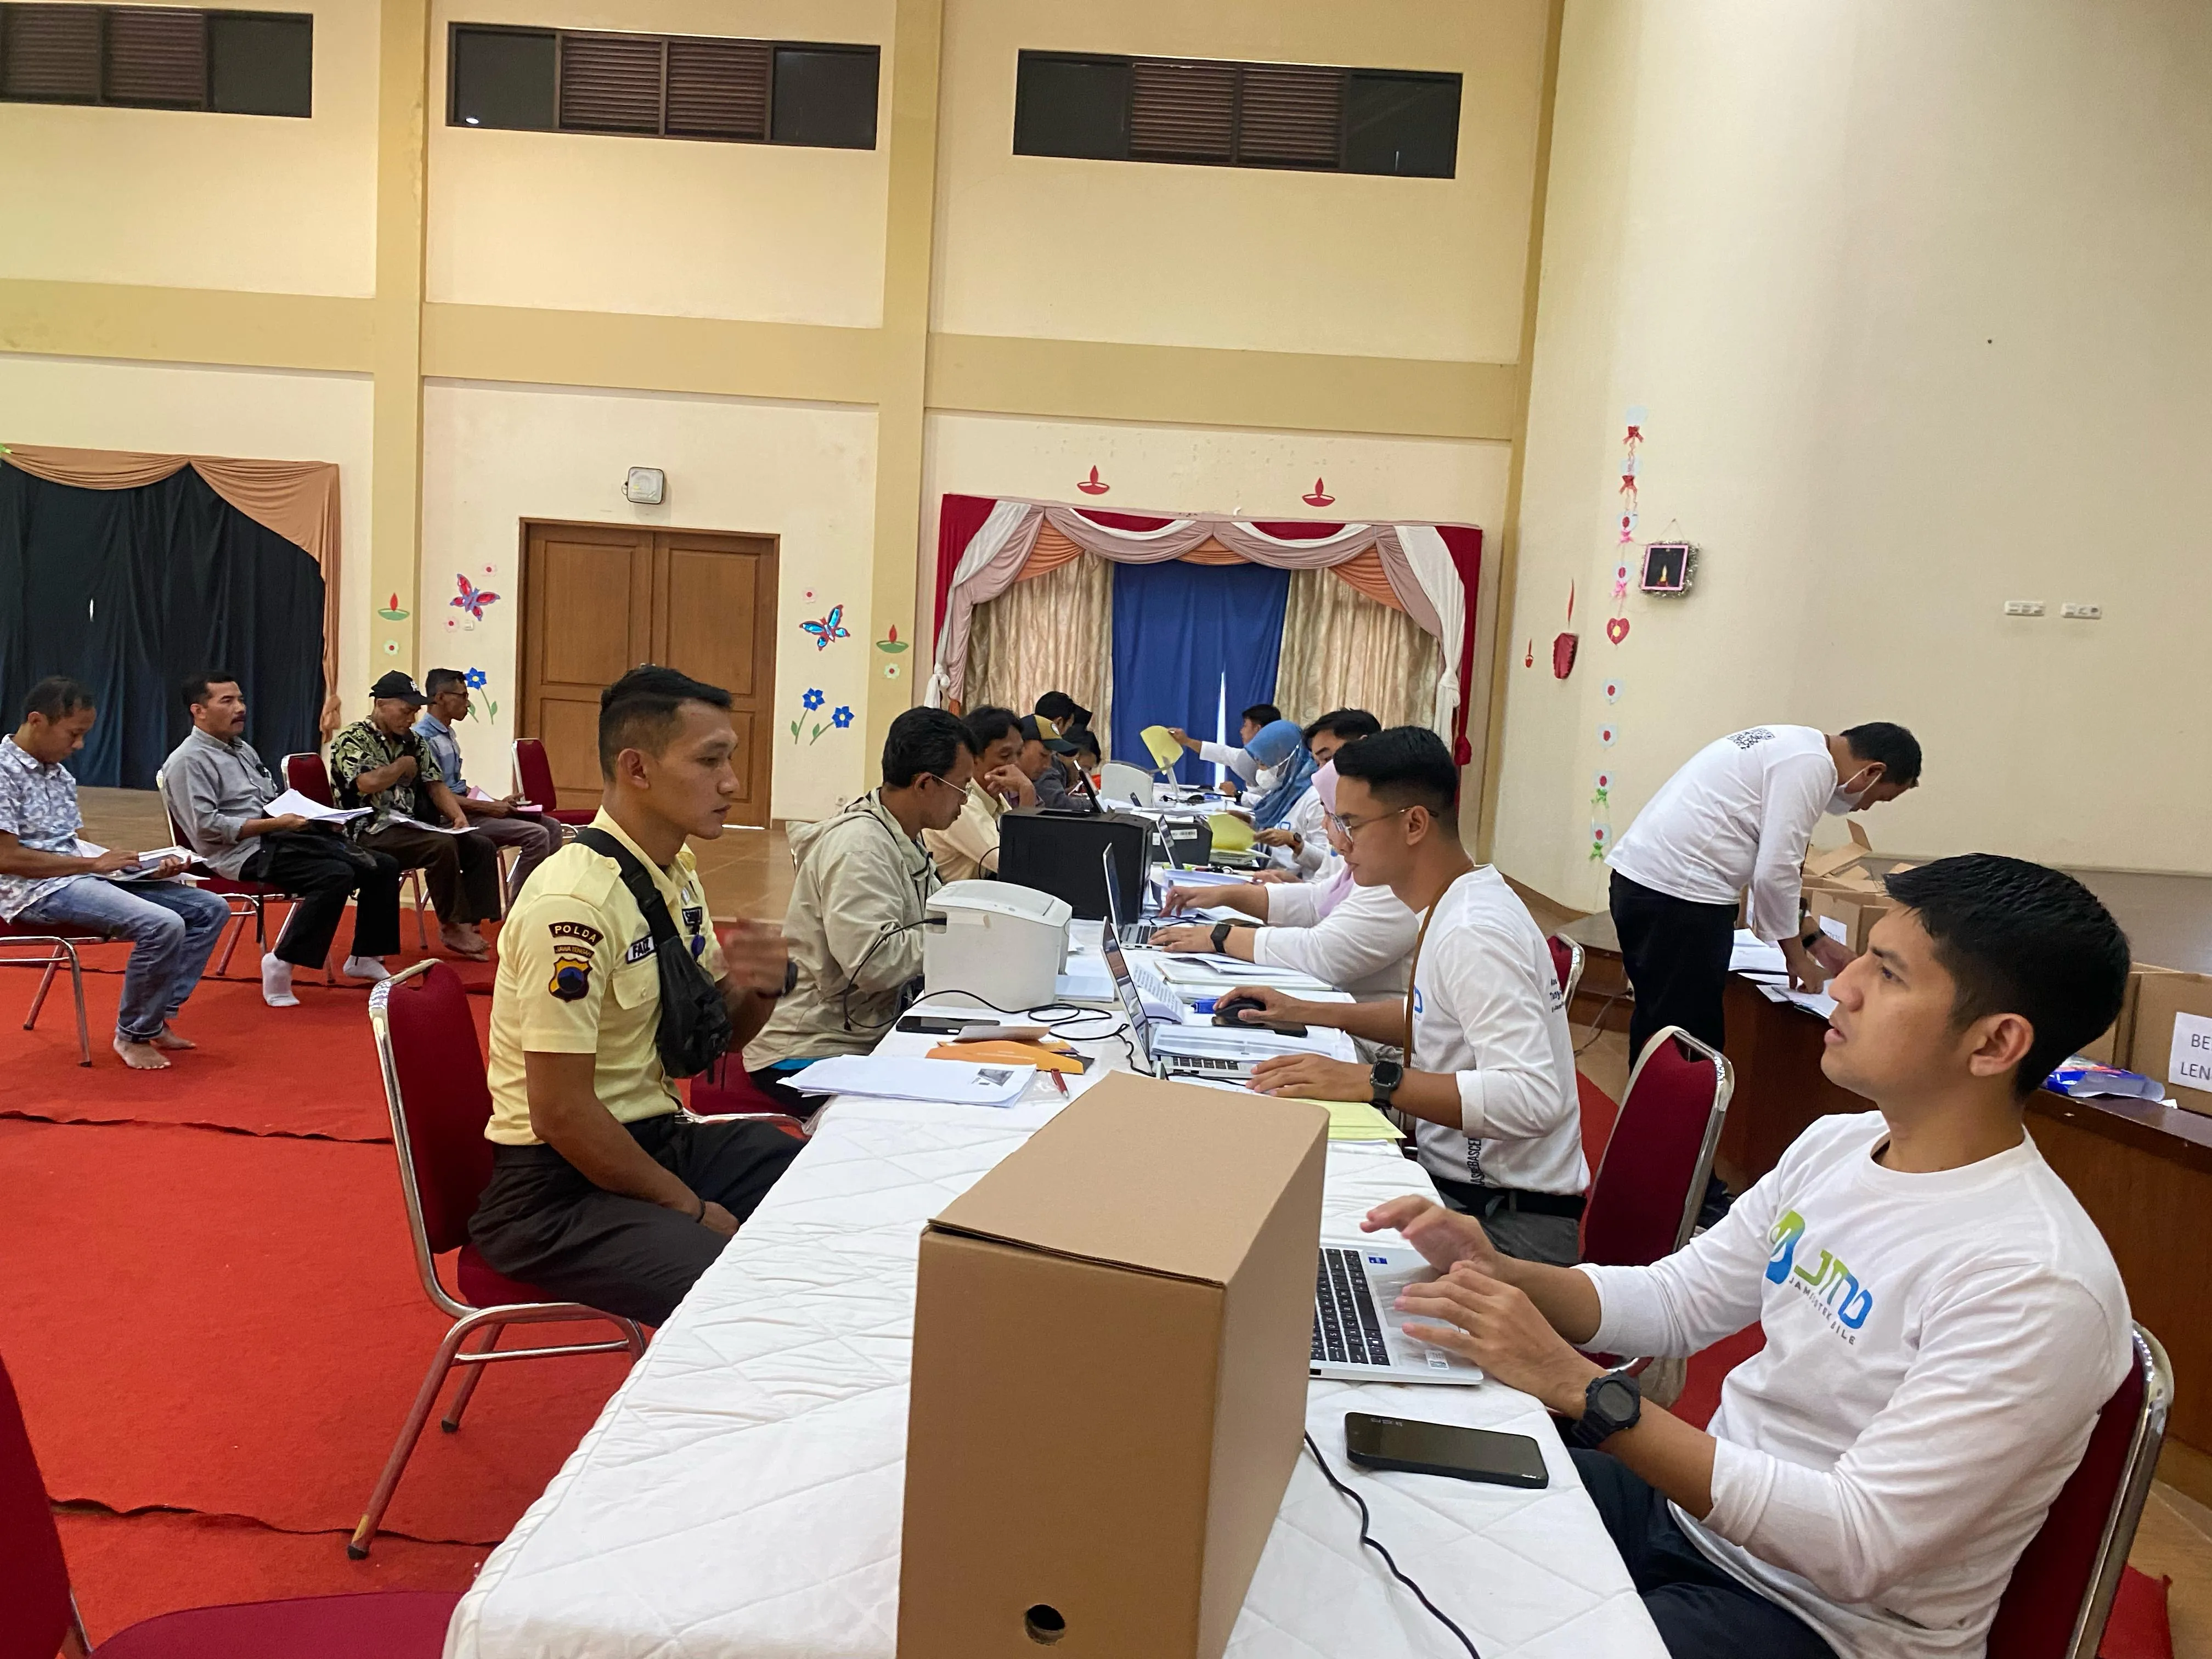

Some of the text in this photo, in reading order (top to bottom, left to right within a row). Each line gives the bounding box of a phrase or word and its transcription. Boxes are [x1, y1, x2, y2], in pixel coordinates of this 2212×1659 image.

[555, 925, 596, 943] POLDA
[633, 938, 651, 958] FAIZ
[2191, 1034, 2212, 1051] BE
[2180, 1062, 2212, 1081] LEN
